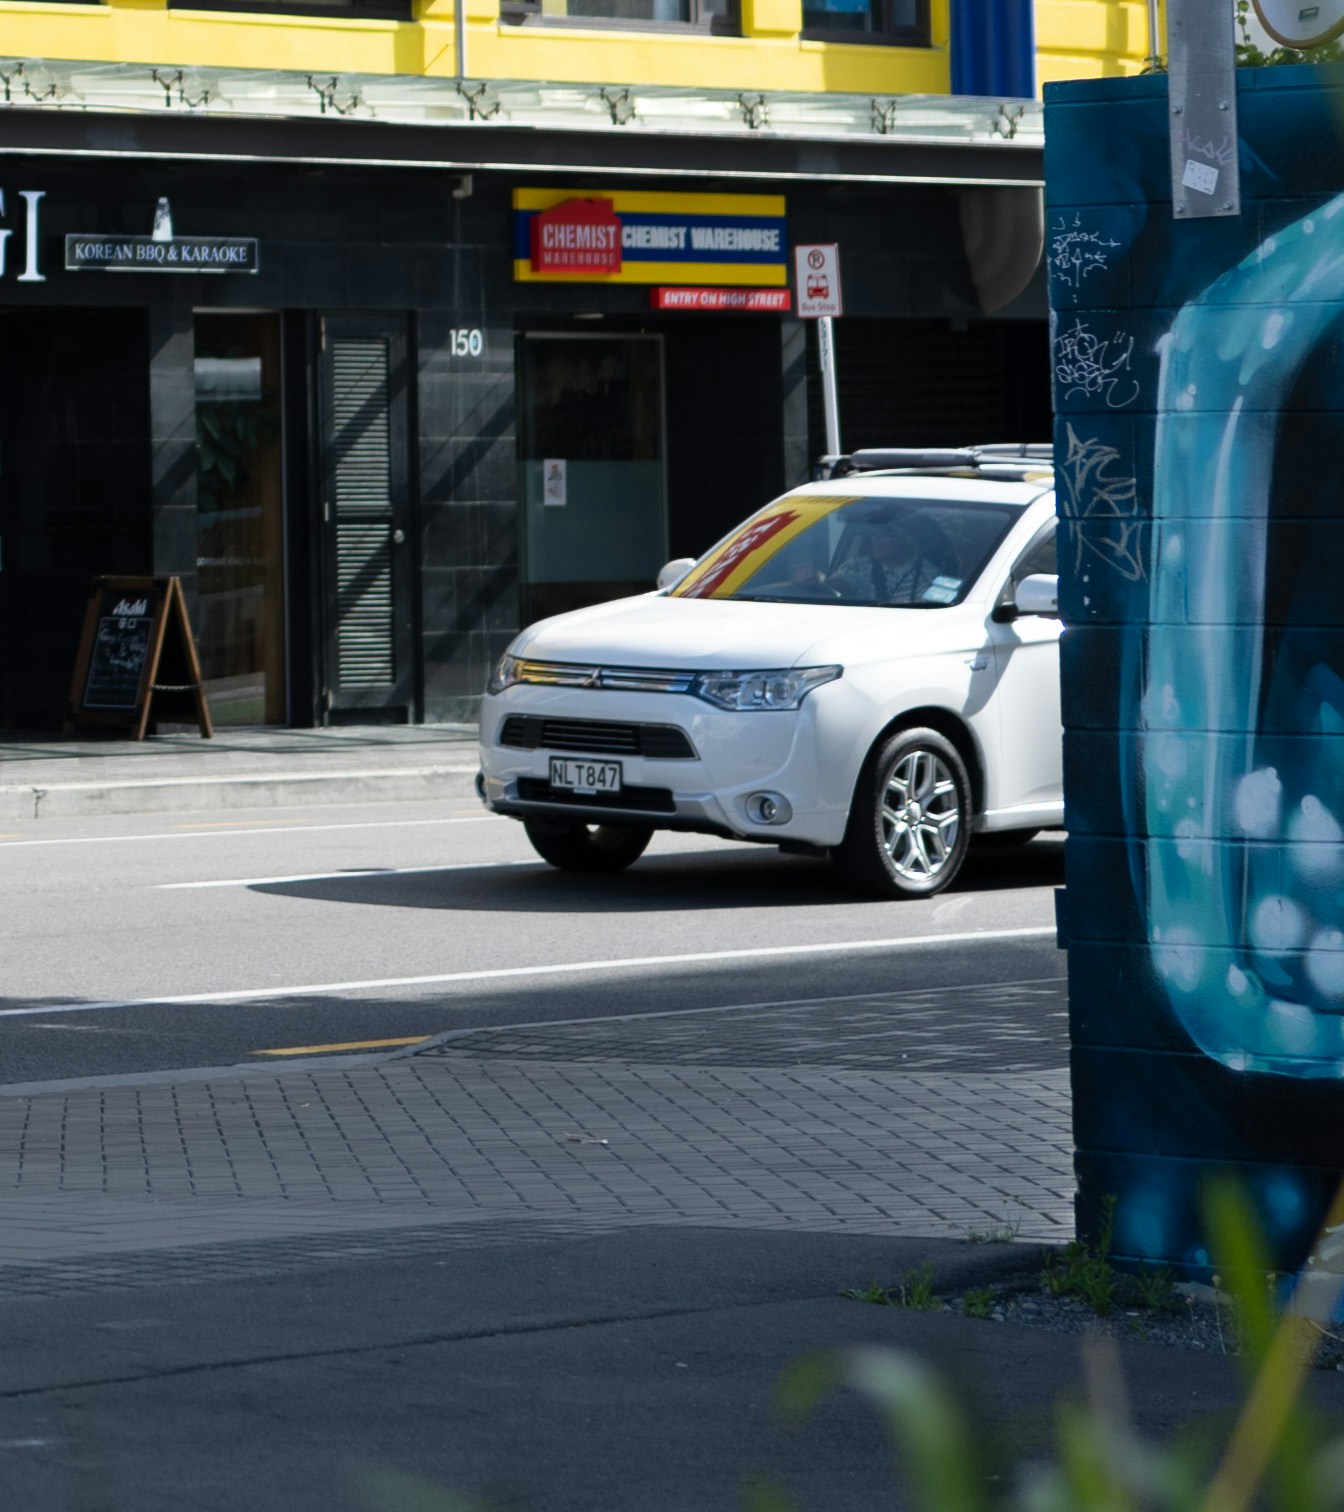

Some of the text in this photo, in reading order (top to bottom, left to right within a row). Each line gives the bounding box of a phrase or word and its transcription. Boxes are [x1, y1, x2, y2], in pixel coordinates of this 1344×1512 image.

[543, 223, 616, 250] CHEMIST
[622, 225, 780, 252] CHEMIST WAREHOUSE
[75, 243, 248, 263] KOREAN BBQ & KARAOKE
[543, 251, 616, 265] WAREHOUSE
[664, 291, 786, 308] ENTRY ON HIGH STREET
[801, 302, 837, 313] Bus Stop
[449, 329, 483, 356] 150
[112, 598, 148, 616] Asahi
[553, 762, 618, 788] NLT847
